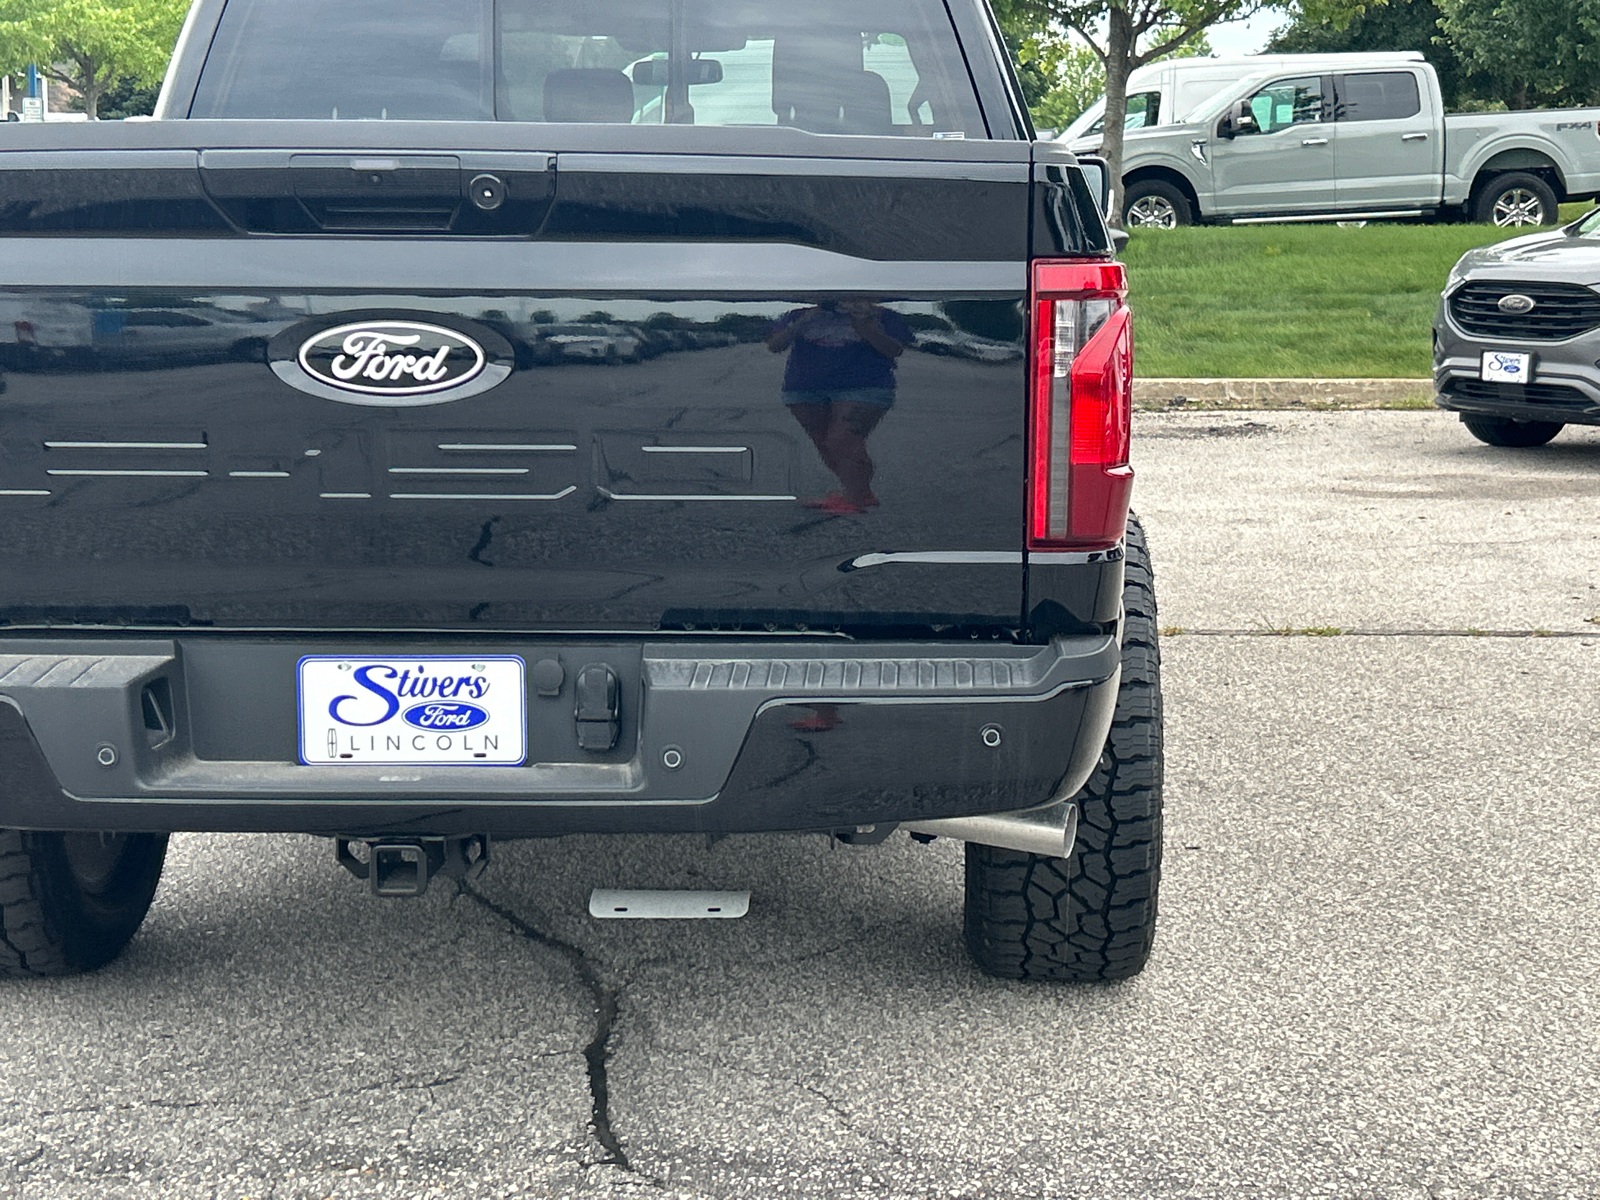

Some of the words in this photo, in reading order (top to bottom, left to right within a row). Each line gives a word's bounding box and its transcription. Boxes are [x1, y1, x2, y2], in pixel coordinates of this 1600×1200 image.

[331, 331, 450, 381] Ford
[328, 664, 490, 727] Stivers
[419, 704, 471, 726] Ford
[350, 735, 498, 751] LINCOLN
